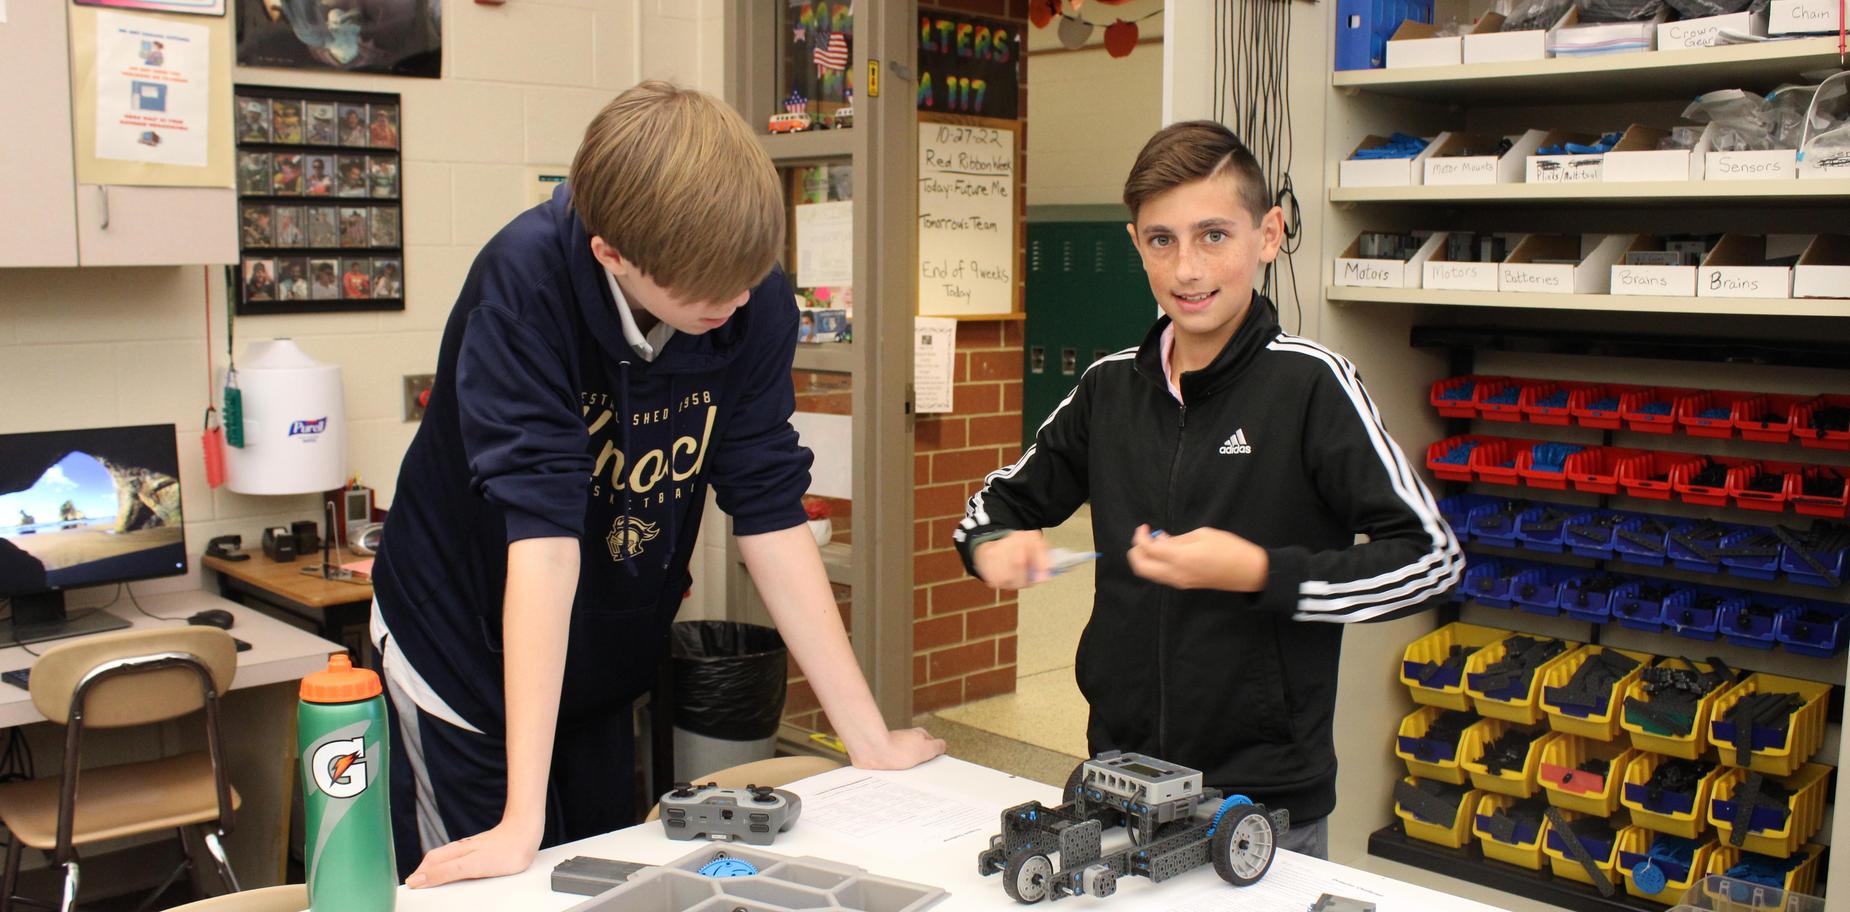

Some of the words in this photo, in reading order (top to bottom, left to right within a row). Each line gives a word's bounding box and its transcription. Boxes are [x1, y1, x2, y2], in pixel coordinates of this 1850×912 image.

[1792, 6, 1831, 22] Chain
[1669, 26, 1718, 40] Crown
[1684, 38, 1713, 48] Gear
[946, 75, 988, 112] 117
[926, 149, 952, 168] Red
[1719, 157, 1781, 173] Sensors
[955, 179, 988, 197] Future
[991, 181, 1008, 197] Me
[969, 216, 997, 232] Team
[922, 260, 948, 279] End
[952, 259, 964, 280] of
[1344, 262, 1389, 282] Motors
[1432, 265, 1478, 280] Motors
[1618, 270, 1667, 287] Brains
[1709, 271, 1759, 291] Brains
[942, 284, 971, 305] Today
[678, 391, 711, 413] 1958
[1219, 444, 1251, 454] adidas
